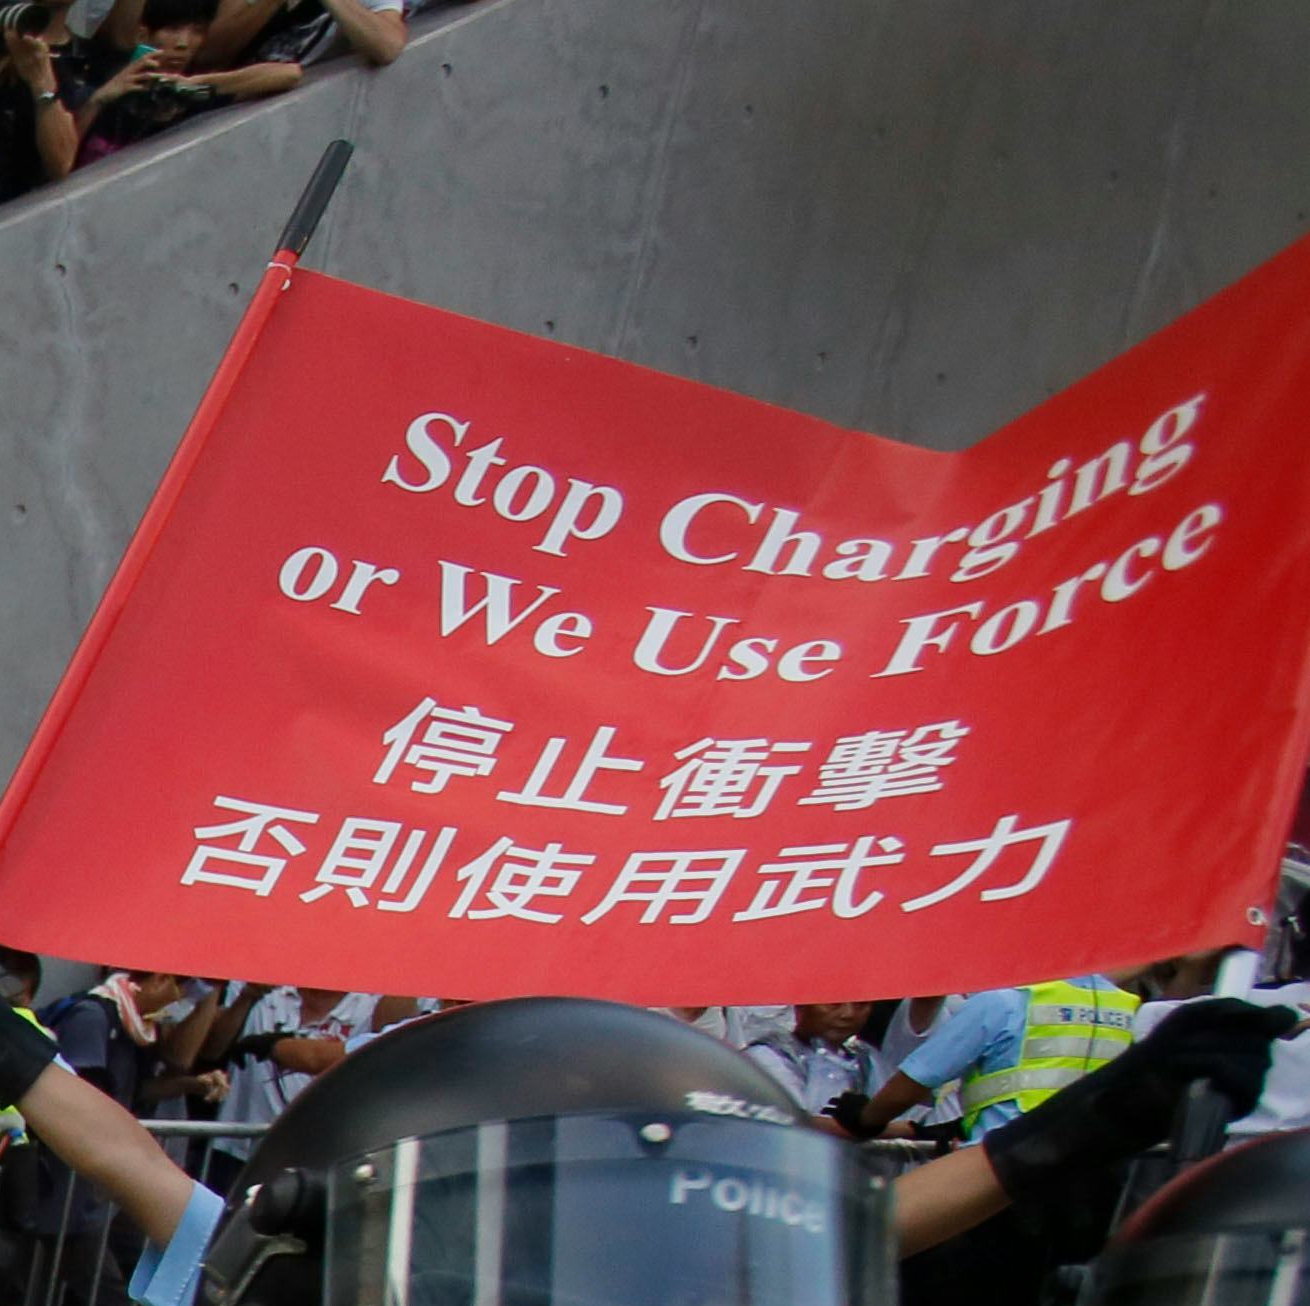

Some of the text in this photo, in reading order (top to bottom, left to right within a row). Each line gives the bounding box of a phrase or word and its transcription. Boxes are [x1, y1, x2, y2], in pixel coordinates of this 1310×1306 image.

[381, 392, 1204, 584] Stop Charging
[279, 503, 1221, 683] or We Use Force
[372, 696, 970, 822] 停止衝擊
[179, 795, 1071, 925] 否則使用武力
